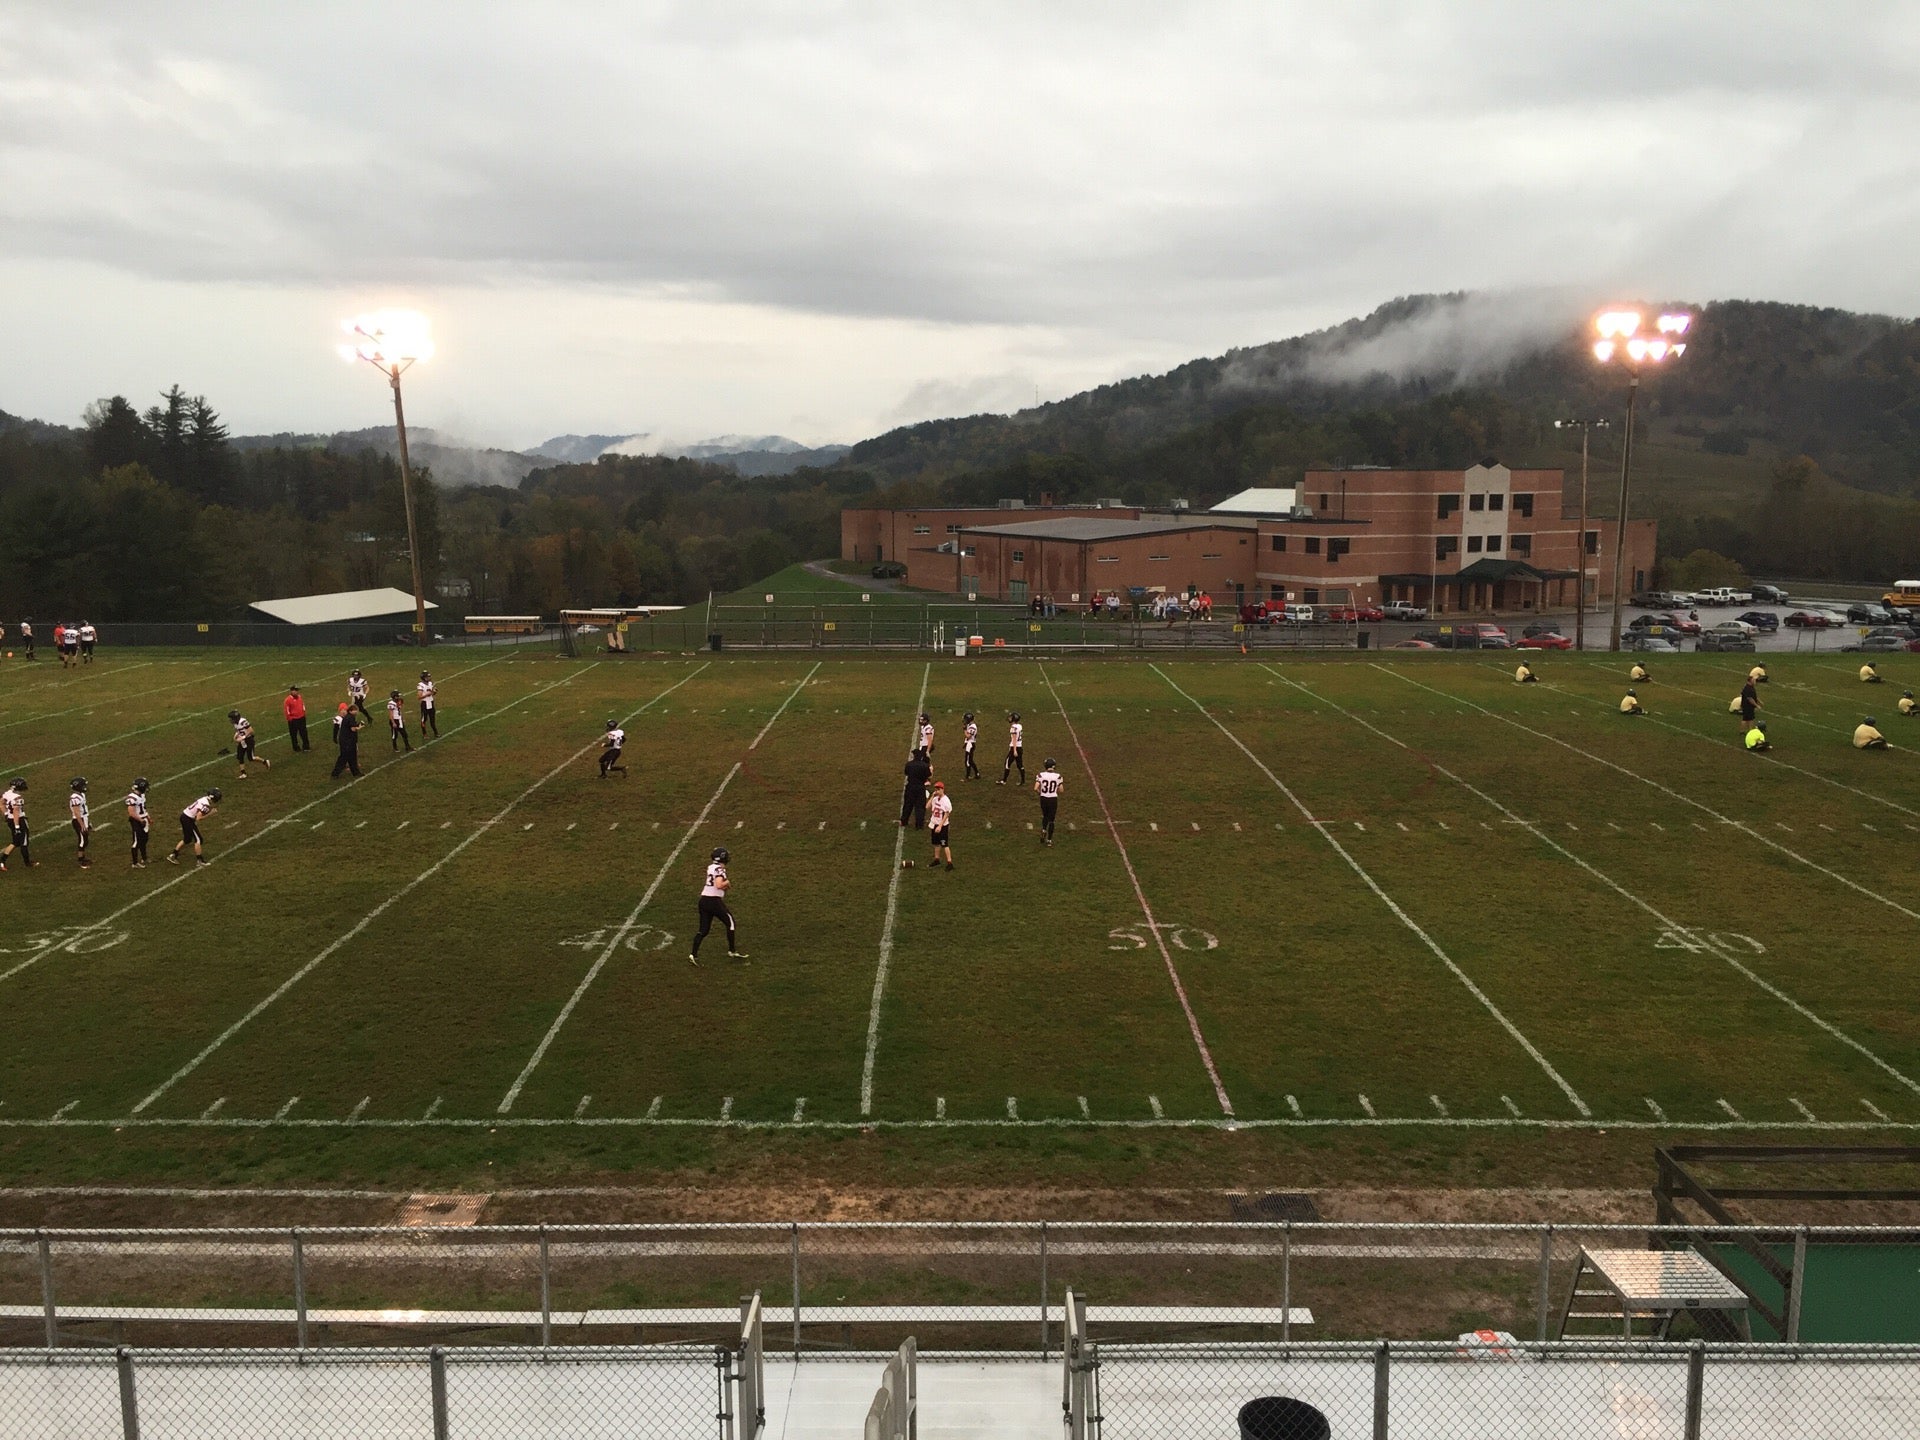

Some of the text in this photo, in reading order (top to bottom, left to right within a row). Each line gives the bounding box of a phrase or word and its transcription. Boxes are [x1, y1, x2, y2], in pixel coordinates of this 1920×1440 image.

[1041, 780, 1057, 794] 30
[0, 929, 129, 954] 30
[558, 928, 676, 952] 40
[1107, 927, 1219, 951] 50
[1654, 931, 1767, 954] 40
